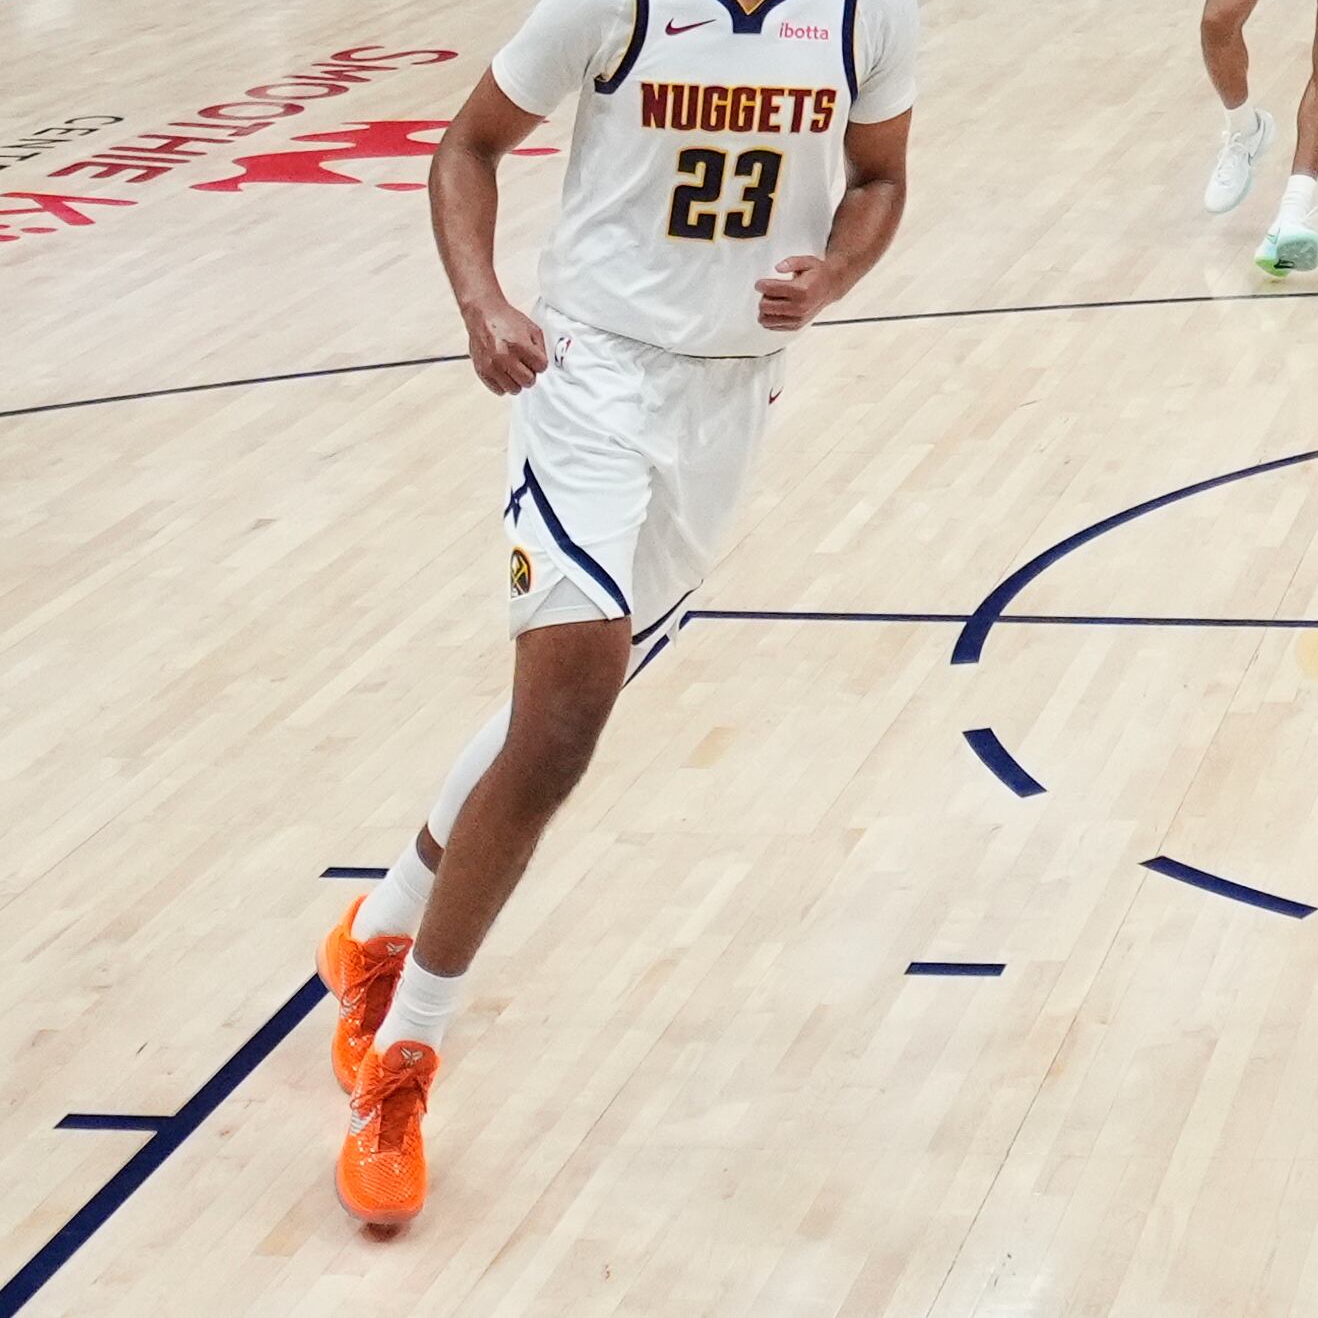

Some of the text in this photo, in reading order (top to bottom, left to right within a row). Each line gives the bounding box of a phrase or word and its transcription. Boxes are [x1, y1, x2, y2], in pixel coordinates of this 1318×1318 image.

[779, 21, 829, 41] ibotta
[47, 45, 459, 183] SMOOTHIE
[639, 81, 838, 134] NUGGETS
[666, 145, 785, 244] 23
